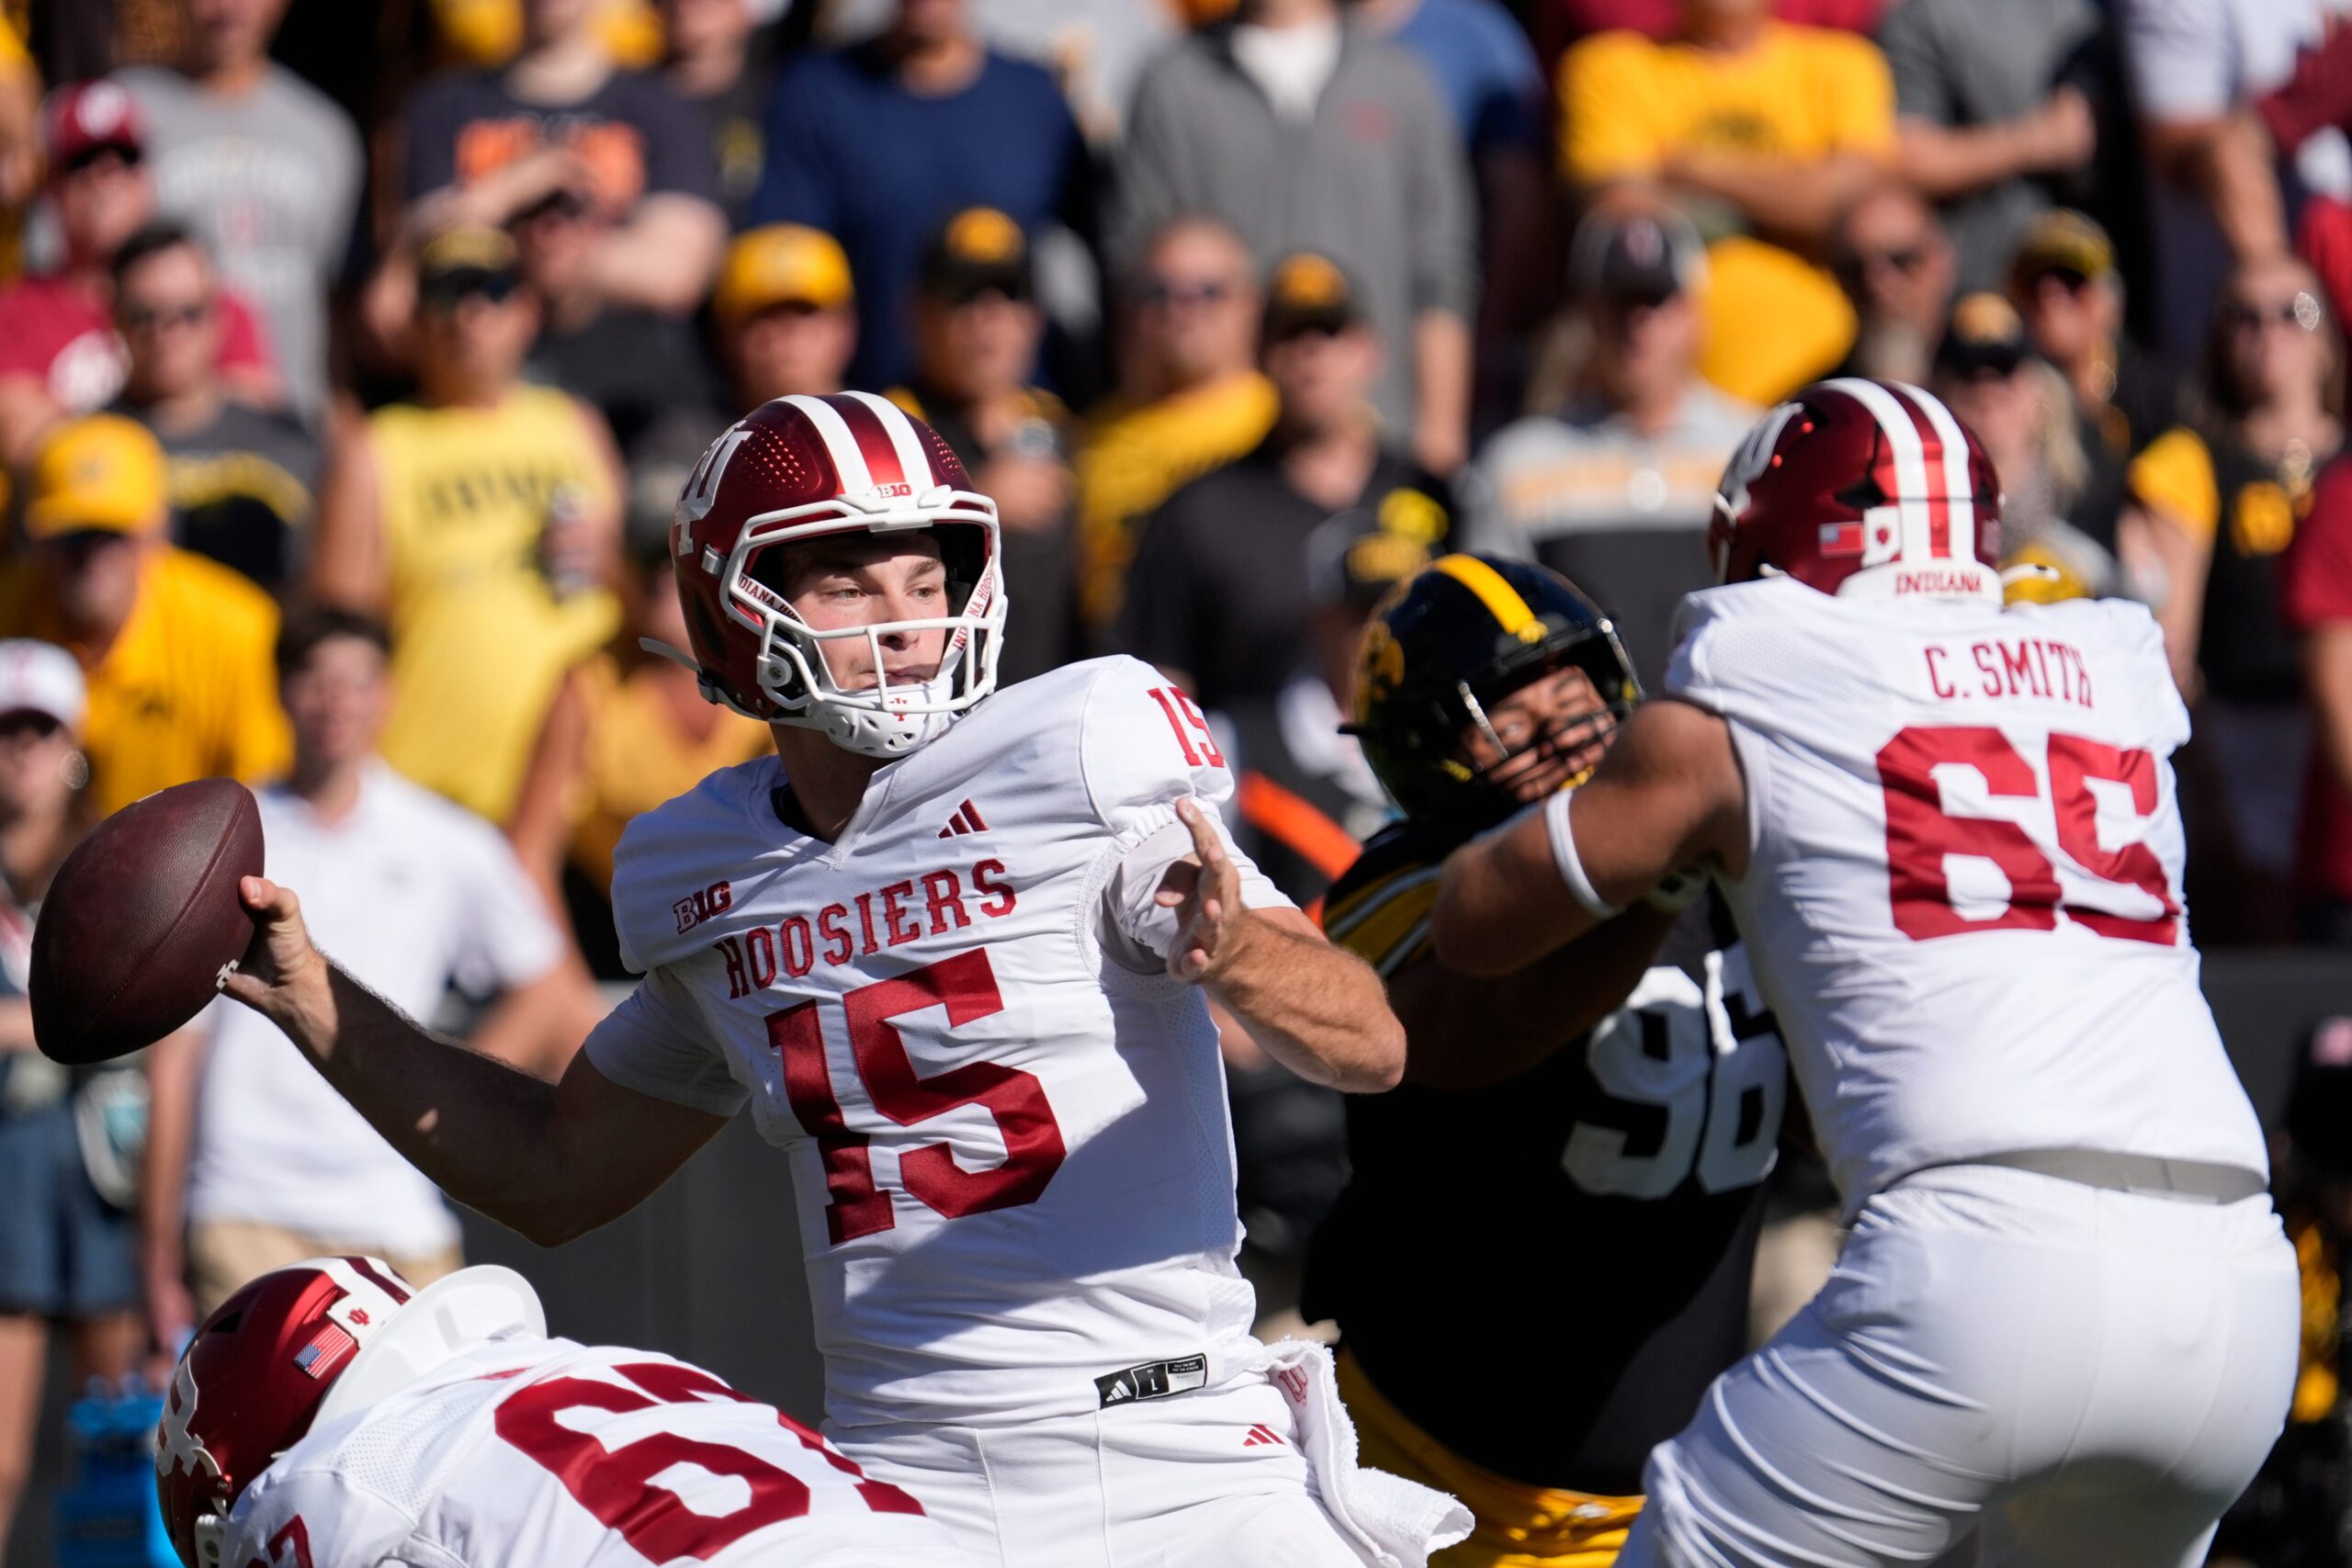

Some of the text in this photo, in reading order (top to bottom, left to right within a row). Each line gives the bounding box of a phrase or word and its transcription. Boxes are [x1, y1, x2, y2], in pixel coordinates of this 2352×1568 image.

[1895, 571, 1983, 595] INDIANA
[1147, 686, 1225, 768] 15
[1972, 638, 2094, 709] SMITH
[1875, 726, 2181, 946] 65
[713, 858, 1017, 1000] HOOSIERS
[764, 947, 1067, 1246] 15
[1561, 944, 1788, 1201] 96
[1150, 1378, 1159, 1392] L
